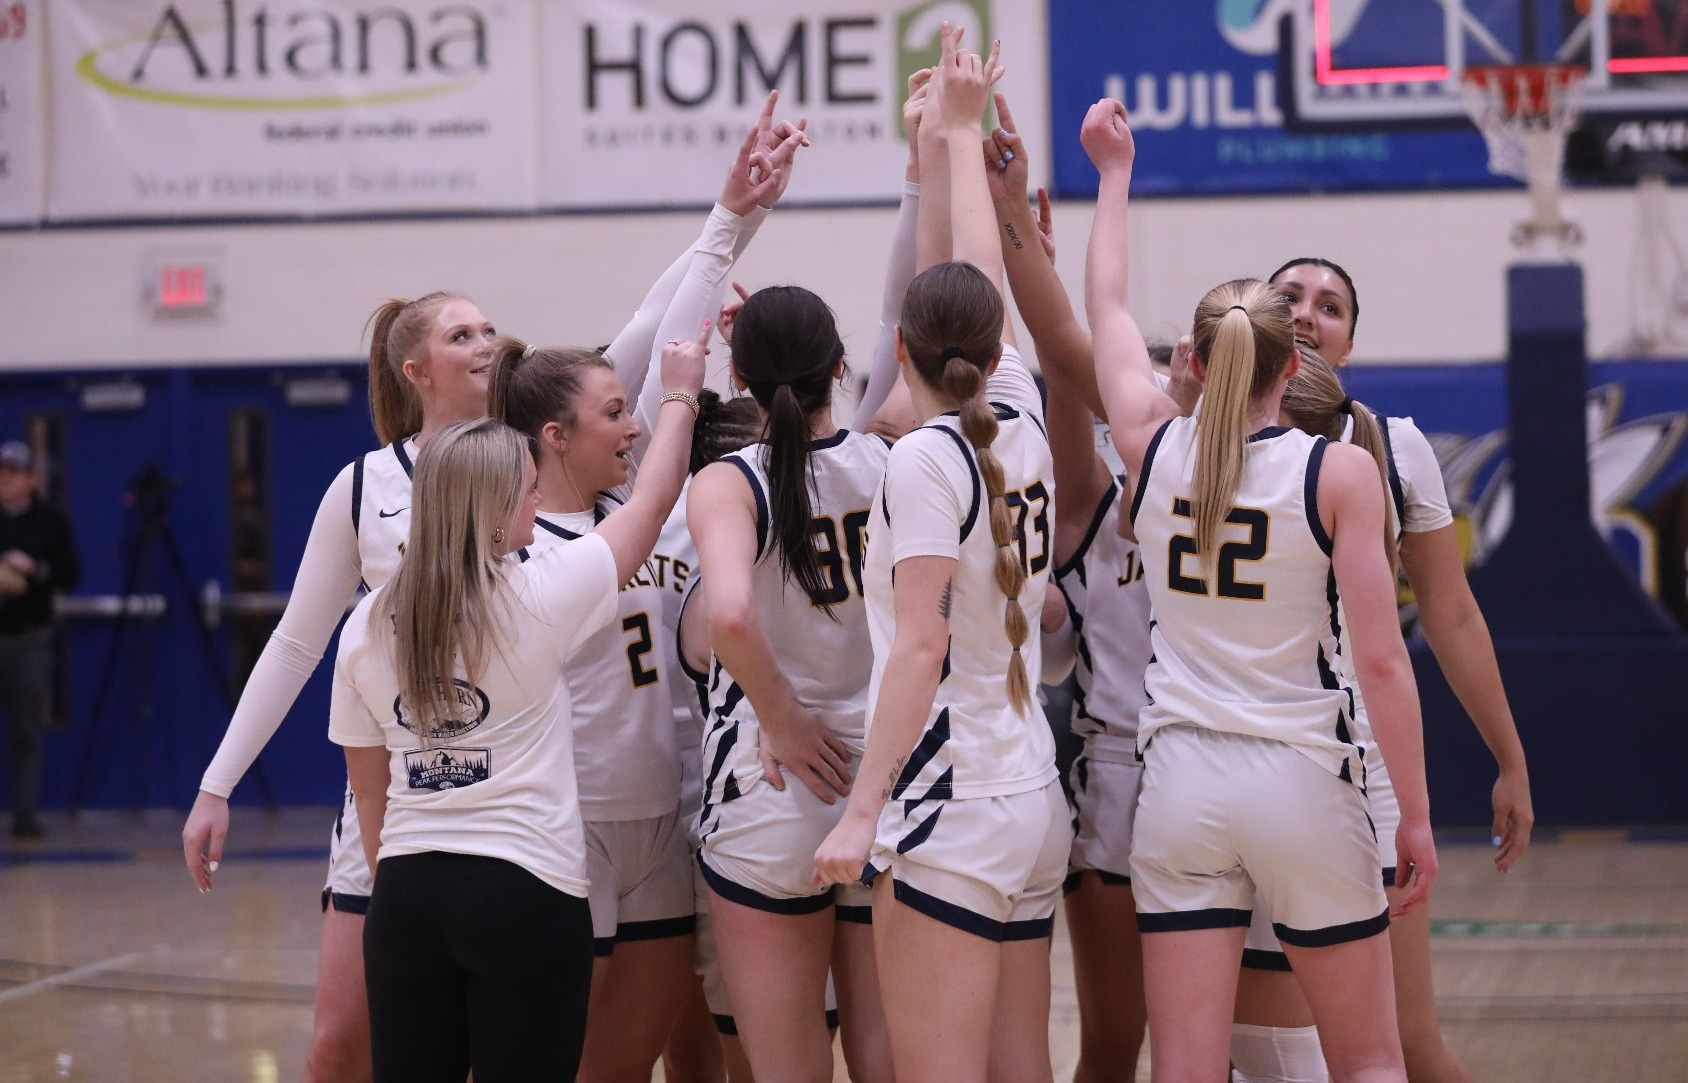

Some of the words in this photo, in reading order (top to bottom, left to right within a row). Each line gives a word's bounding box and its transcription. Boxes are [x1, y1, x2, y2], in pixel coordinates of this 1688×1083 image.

[131, 0, 490, 81] Altana
[582, 16, 880, 110] HOME
[1167, 495, 1271, 601] 22
[622, 611, 660, 689] 2
[415, 777, 432, 788] PEAK
[420, 766, 475, 779] MONTANA
